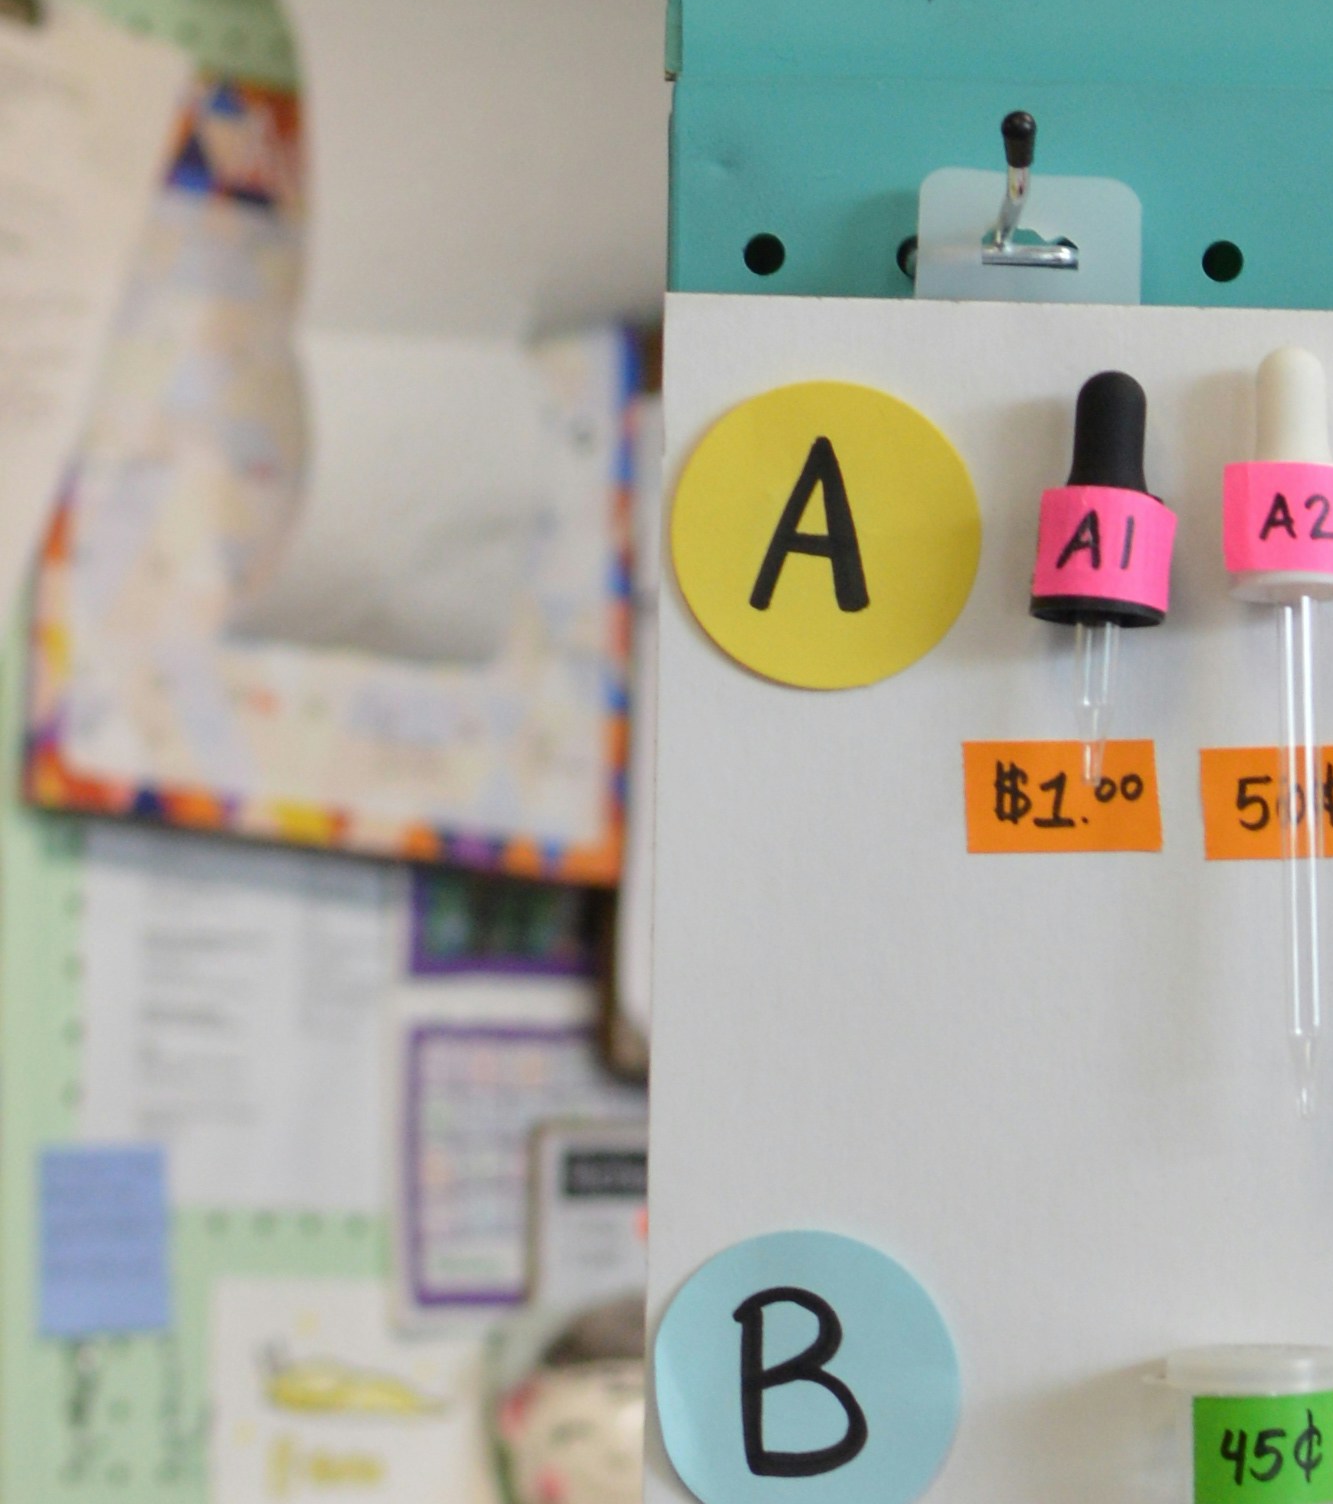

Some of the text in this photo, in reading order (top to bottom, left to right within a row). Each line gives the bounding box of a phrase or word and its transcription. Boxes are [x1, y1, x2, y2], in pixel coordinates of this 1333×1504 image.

[749, 435, 872, 613] A
[1056, 510, 1135, 572] A1
[994, 759, 1144, 829] $1.00
[734, 1286, 868, 1479] B
[1219, 1410, 1326, 1485] 45¢
